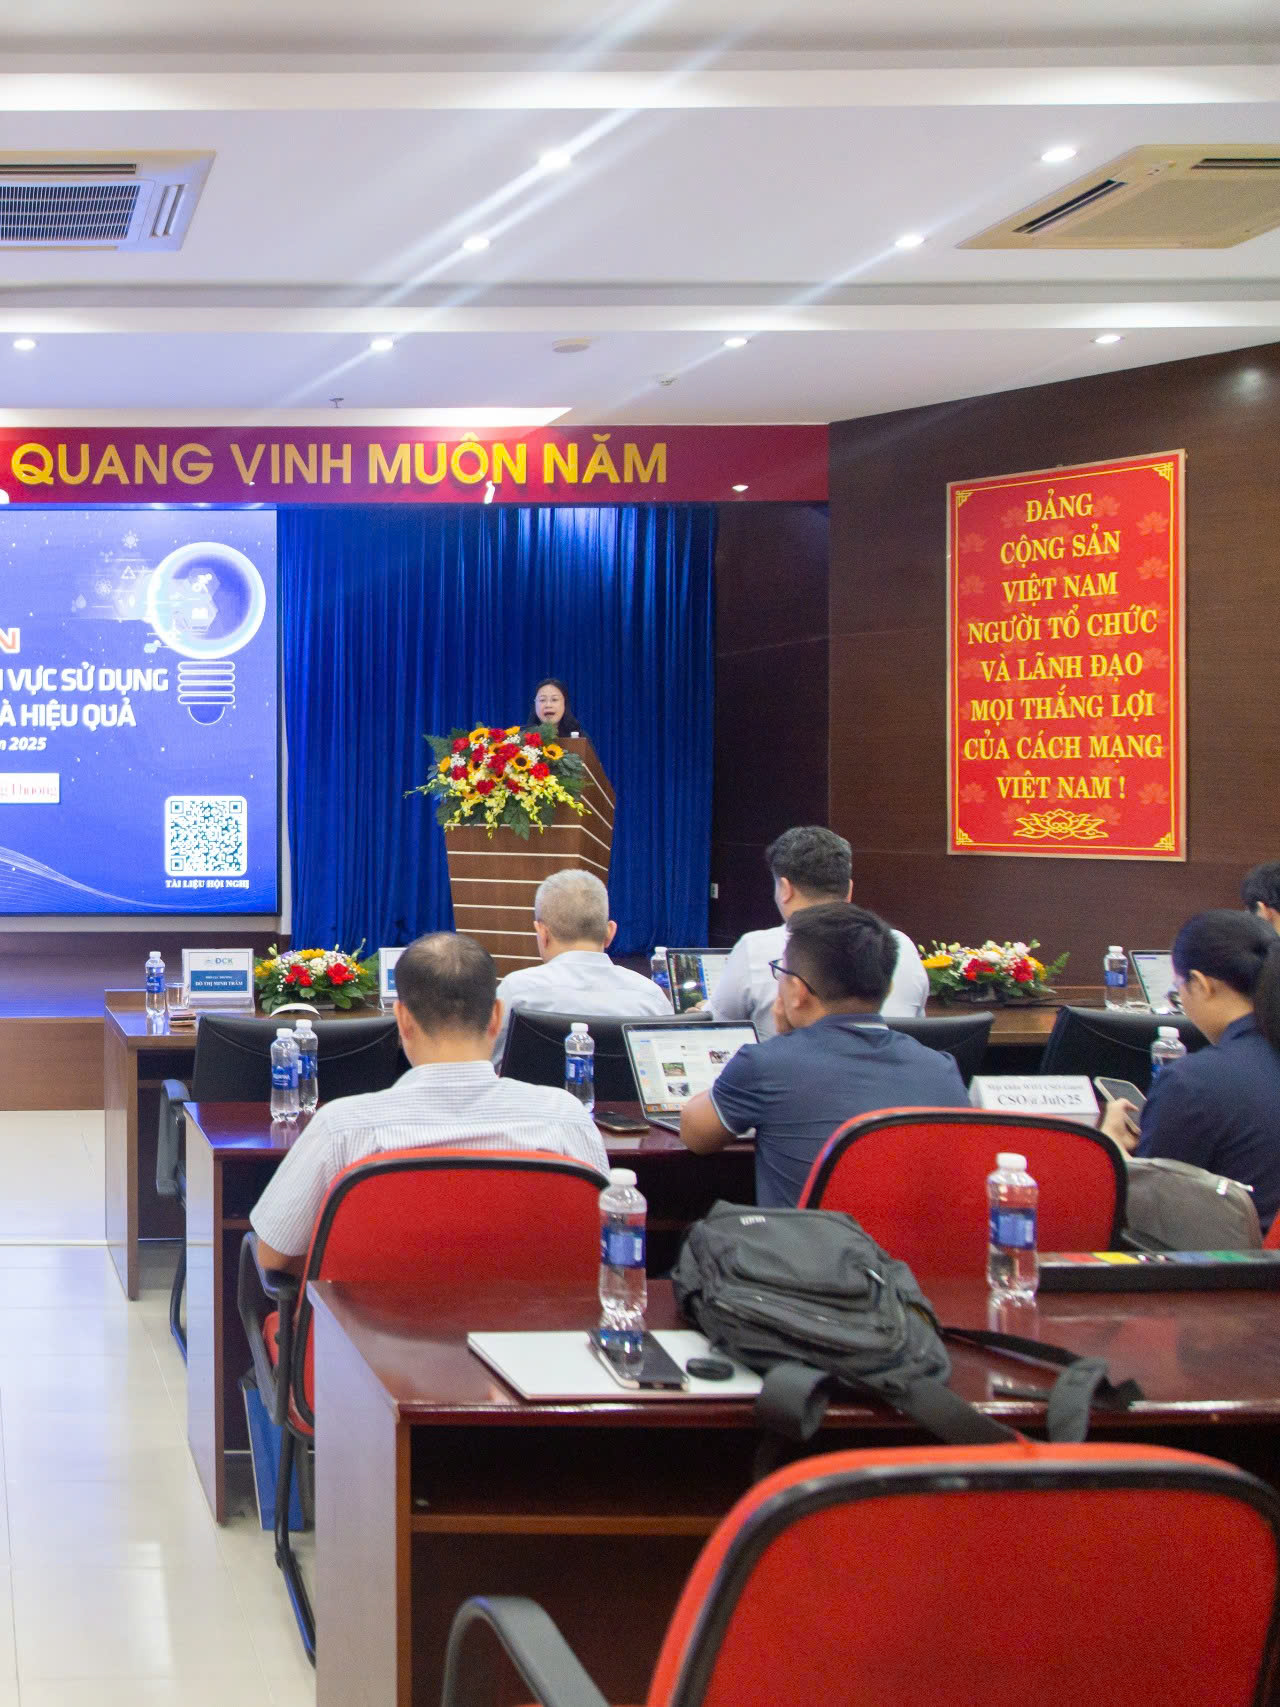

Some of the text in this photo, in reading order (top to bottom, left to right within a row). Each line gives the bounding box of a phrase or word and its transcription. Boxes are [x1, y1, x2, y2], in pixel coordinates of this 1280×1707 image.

[11, 443, 214, 484] QUANG
[232, 442, 351, 483] VINH
[369, 436, 527, 484] MUÔN
[543, 434, 666, 483] NĂM
[1026, 489, 1092, 522] ĐẢNG
[1001, 523, 1120, 567] CỘNG SẢN
[1002, 572, 1118, 602] VIỆT NAM
[968, 604, 1157, 644] NGƯỜI TỔ CHỨC
[8, 666, 57, 695] VỰC
[65, 662, 99, 690] SỬ
[102, 669, 168, 695] DỤNG
[980, 652, 1143, 682] VÀ LÃNH ĐẠO
[21, 699, 77, 730] HIỆU
[83, 697, 136, 731] QUẢ
[971, 684, 1155, 726] MỌI THẮNG LỢI
[9, 737, 46, 750] 2025
[964, 729, 1164, 763] CỦA CÁCH MẠNG
[997, 770, 1050, 804] VIỆT
[1057, 776, 1112, 798] NAM
